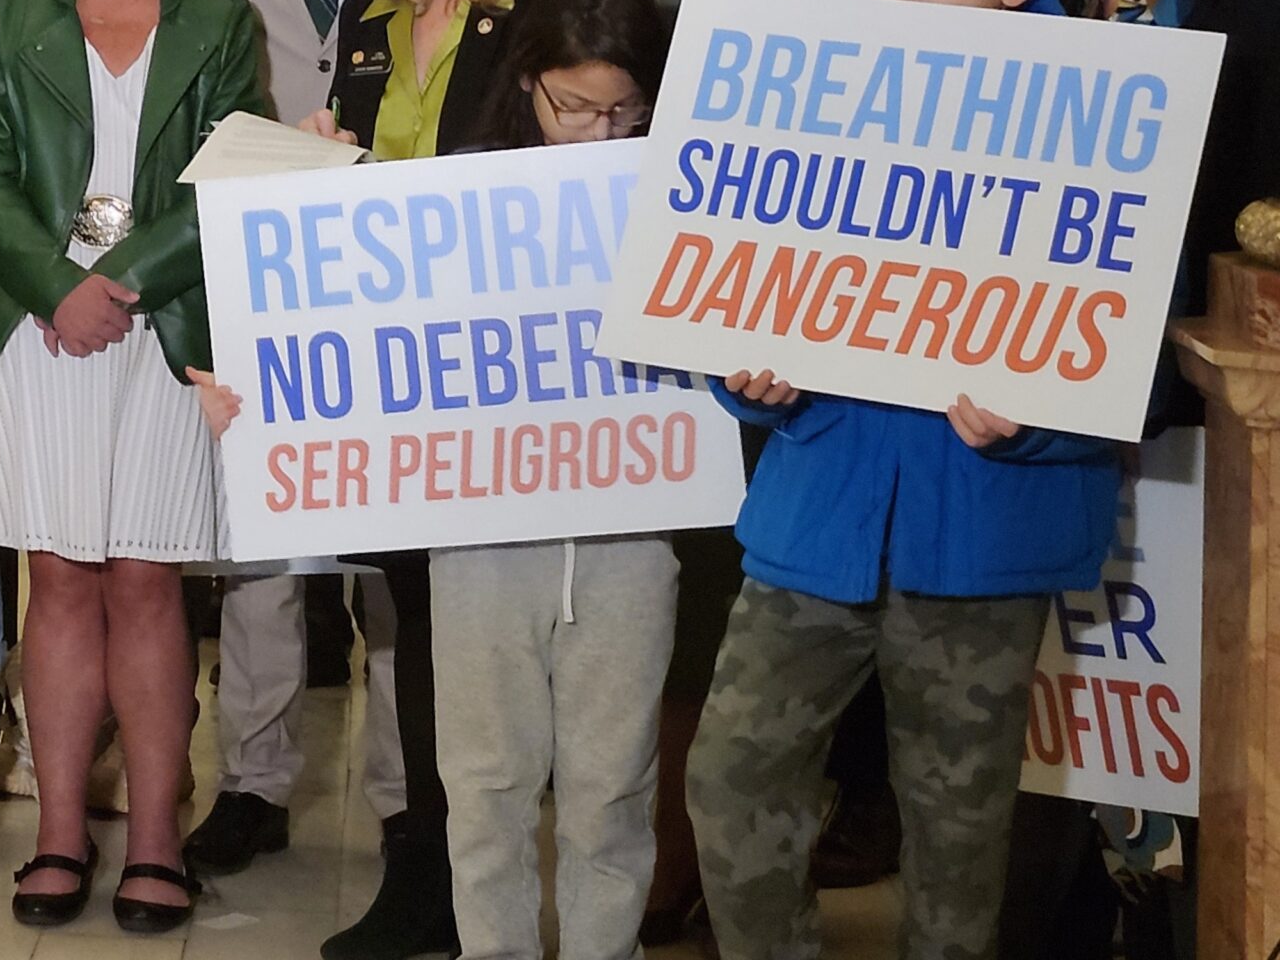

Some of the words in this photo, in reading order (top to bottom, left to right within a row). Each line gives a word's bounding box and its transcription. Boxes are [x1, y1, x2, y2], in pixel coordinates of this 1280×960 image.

[691, 26, 1169, 174] BREATHING
[667, 138, 1041, 258] SHOULDN'T
[1048, 184, 1148, 273] BE
[641, 231, 1128, 382] DANGEROUS
[255, 329, 354, 425] NO
[265, 438, 371, 514] SER
[388, 411, 697, 505] PELIGROSO
[1053, 580, 1167, 665] ER
[1022, 669, 1191, 784] OFITS
